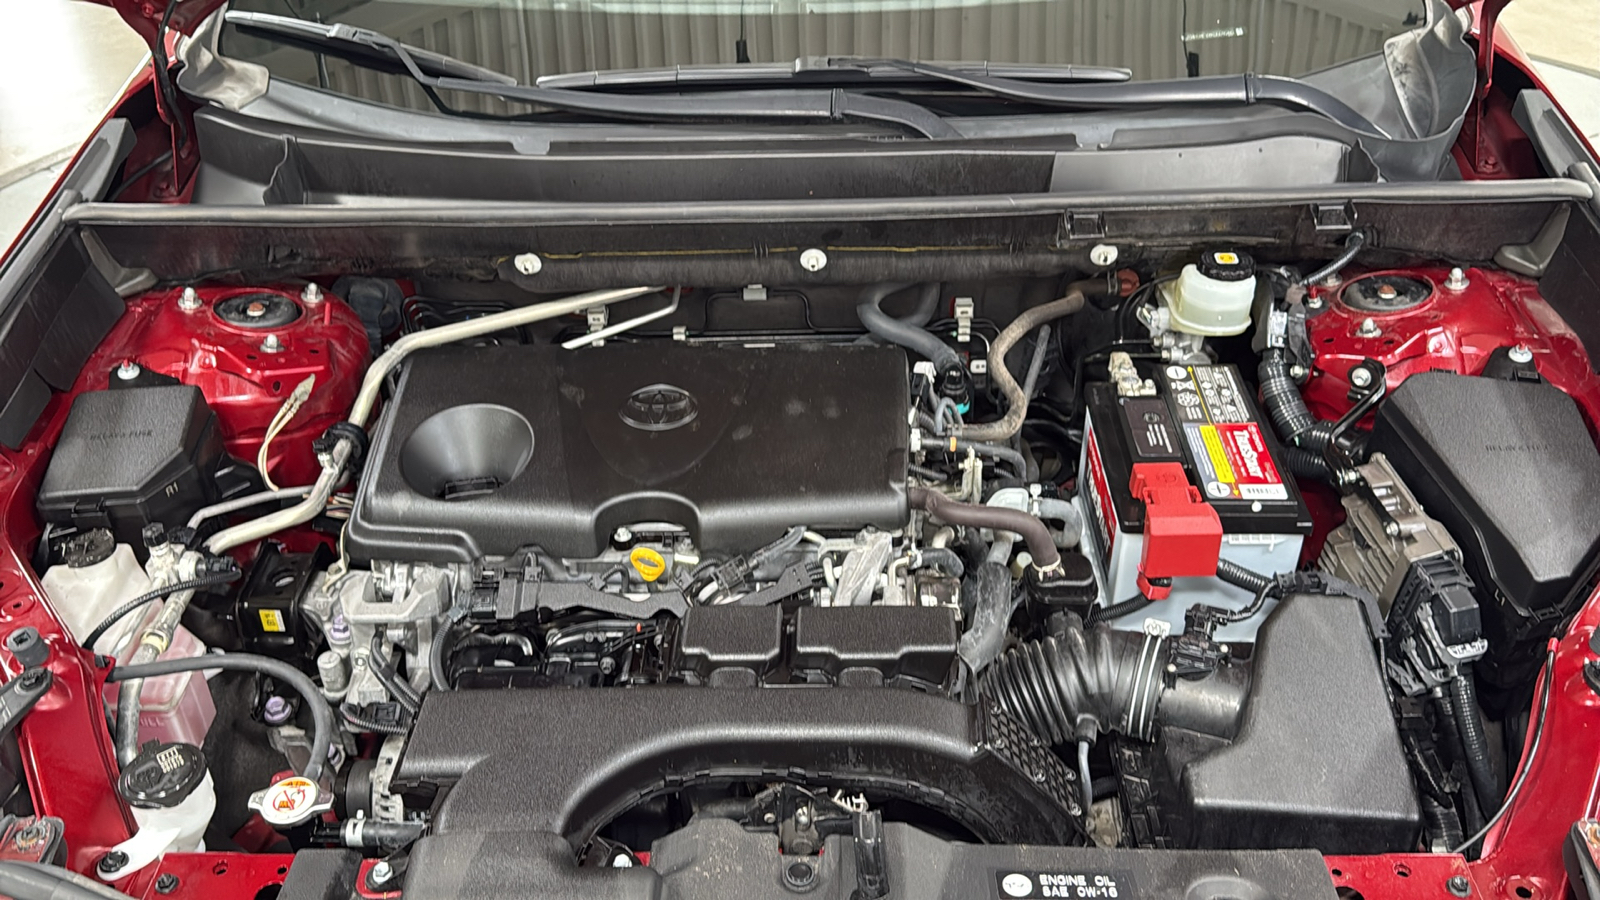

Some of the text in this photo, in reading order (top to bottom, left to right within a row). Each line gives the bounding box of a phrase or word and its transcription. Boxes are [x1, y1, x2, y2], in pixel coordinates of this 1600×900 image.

[1039, 874, 1116, 887] ENGINE OIL
[1042, 886, 1069, 898] SAE
